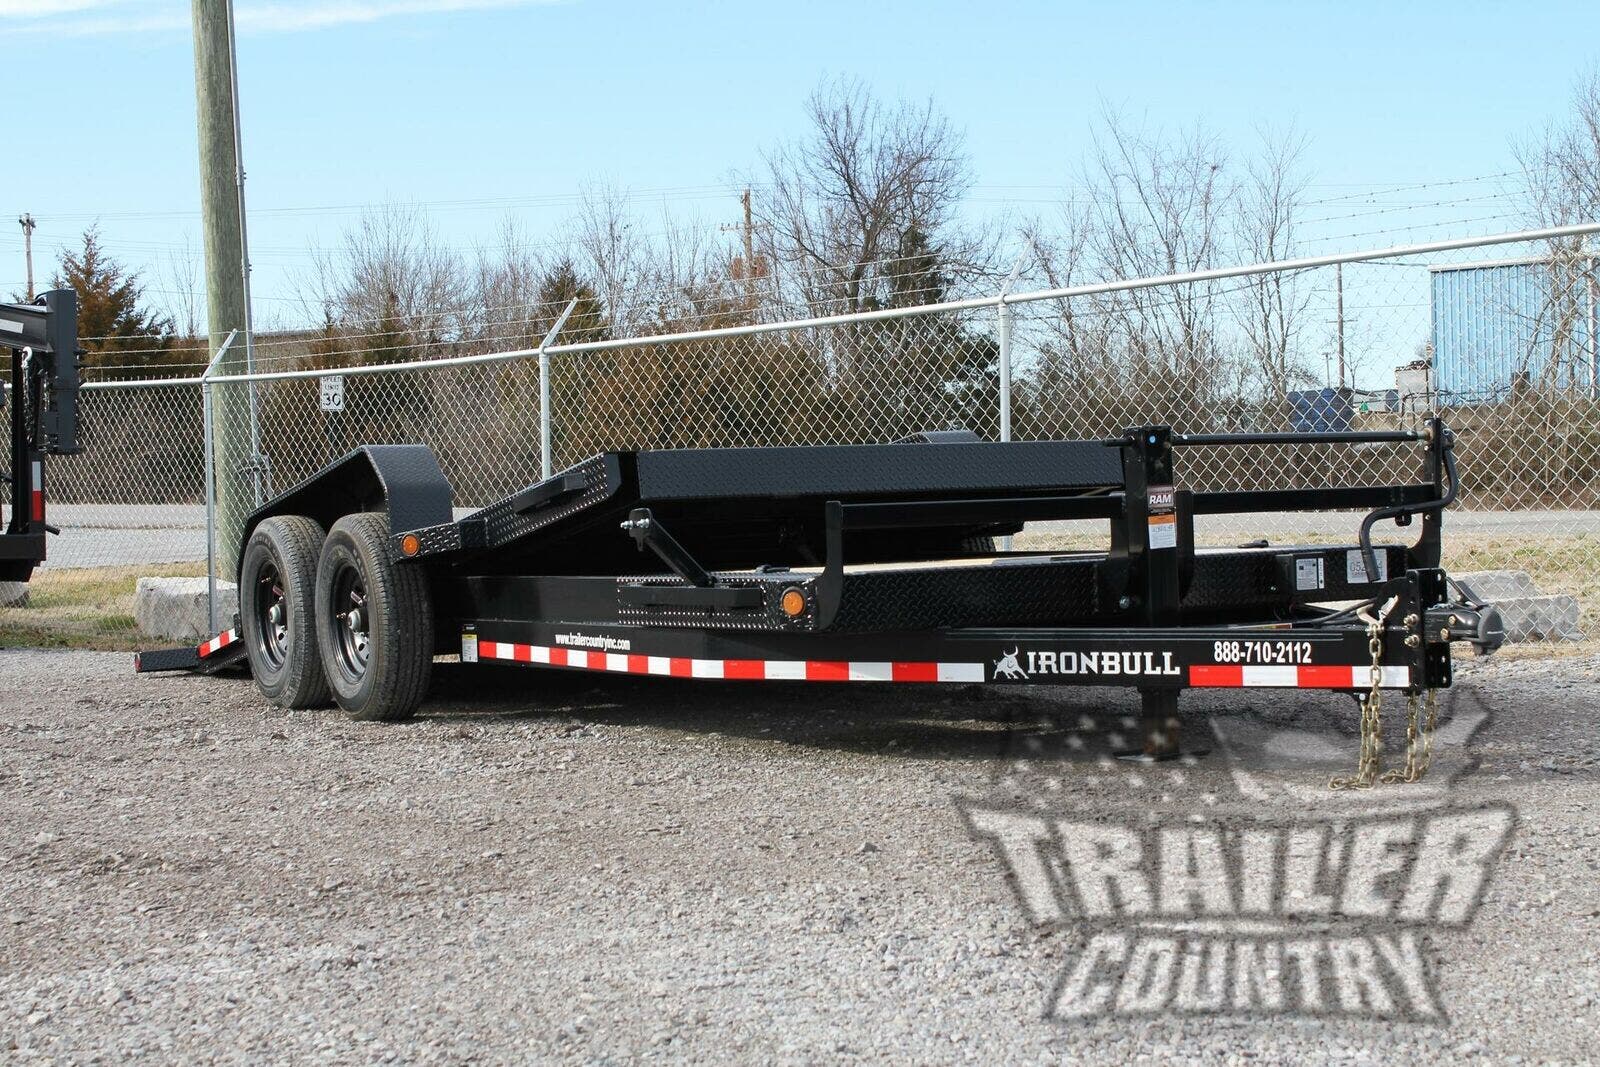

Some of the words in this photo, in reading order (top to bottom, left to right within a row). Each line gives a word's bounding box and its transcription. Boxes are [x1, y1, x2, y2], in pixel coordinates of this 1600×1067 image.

[323, 393, 341, 406] 30
[1149, 494, 1173, 504] RAM
[555, 632, 631, 651] www.trailercountryinc.com
[1213, 641, 1312, 664] 888-710-2112
[1026, 651, 1181, 675] IRONBULL
